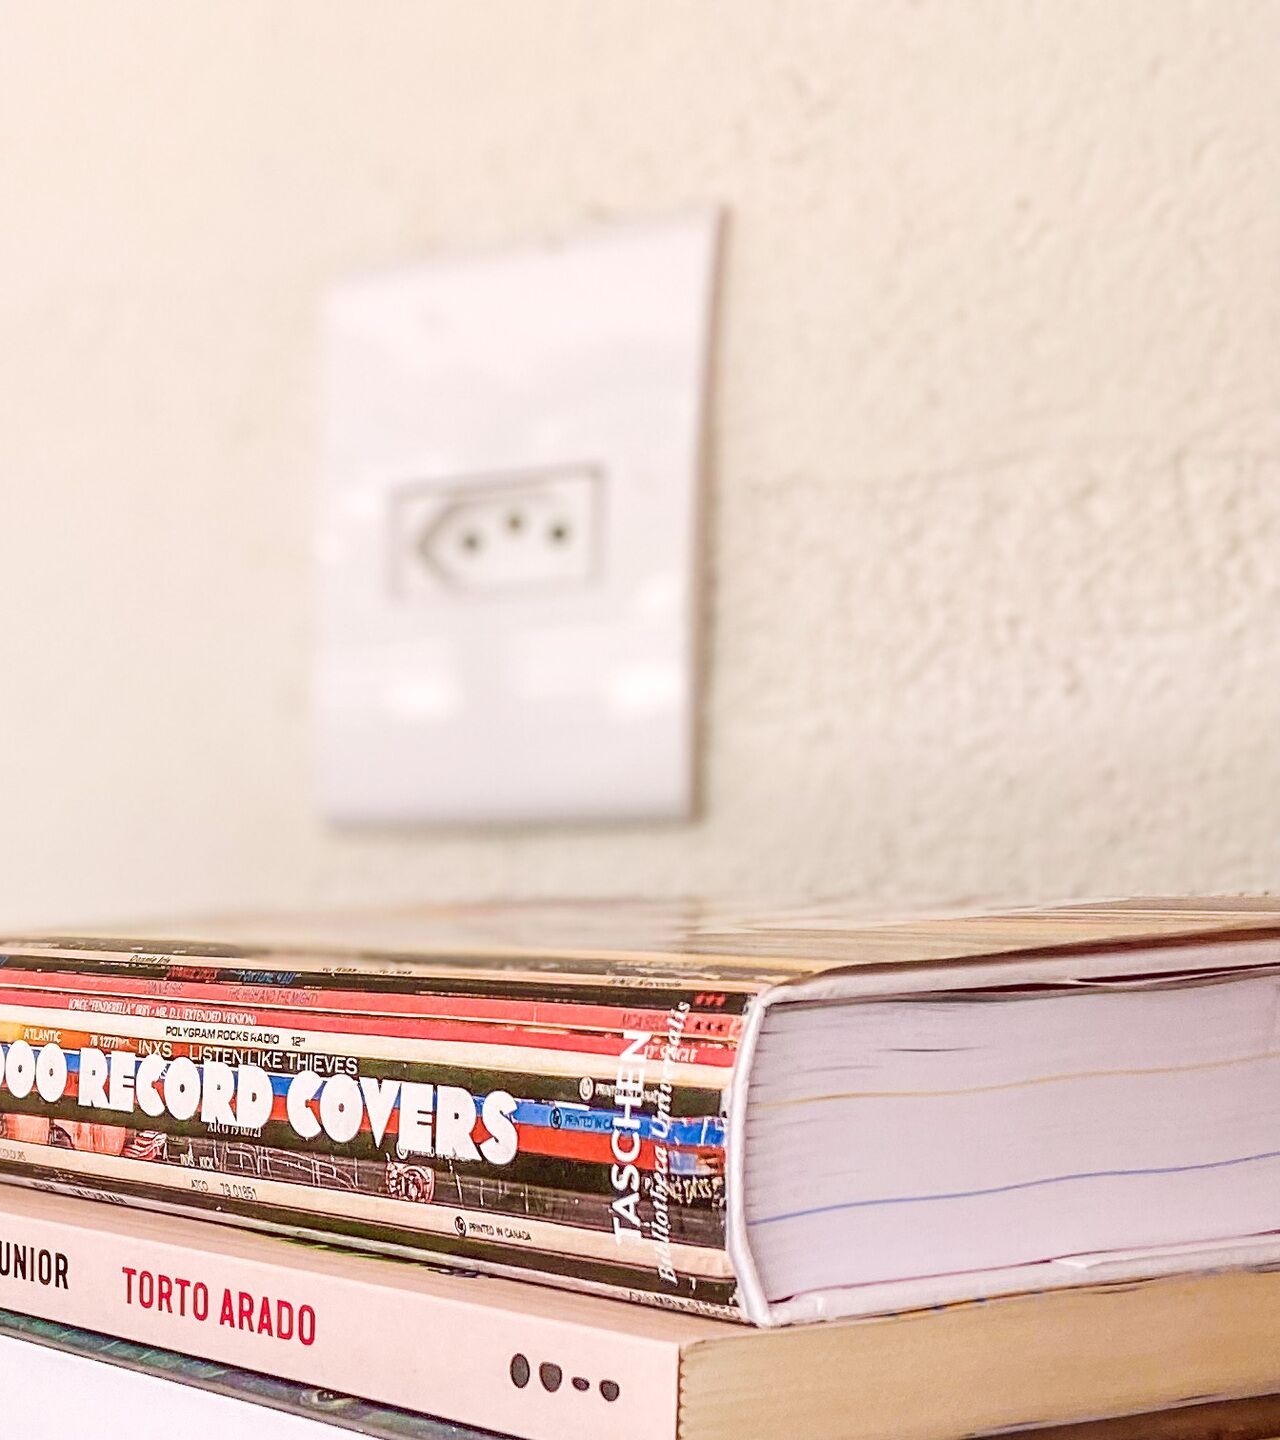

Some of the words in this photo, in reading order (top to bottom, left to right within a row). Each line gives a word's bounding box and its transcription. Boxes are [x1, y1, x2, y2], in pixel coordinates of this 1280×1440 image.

[23, 1027, 62, 1044] ATLANTIC
[165, 1025, 216, 1040] POLYGRAM
[217, 1029, 249, 1042] ROCKS
[250, 1032, 280, 1045] RADIO
[138, 1039, 173, 1058] INXS
[189, 1044, 243, 1065] LISTEN
[247, 1050, 283, 1069] LIKE
[285, 1052, 358, 1075] THIEVES
[78, 1047, 274, 1129] RECORD
[287, 1070, 519, 1166] COVERS
[564, 1113, 592, 1129] PRINTED
[611, 1030, 654, 1247] TASCHEN
[468, 1221, 495, 1237] PRINTED
[496, 1226, 503, 1238] IN
[504, 1228, 533, 1242] CANADA
[121, 1266, 209, 1321] TORTO
[219, 1288, 316, 1346] ARADO
